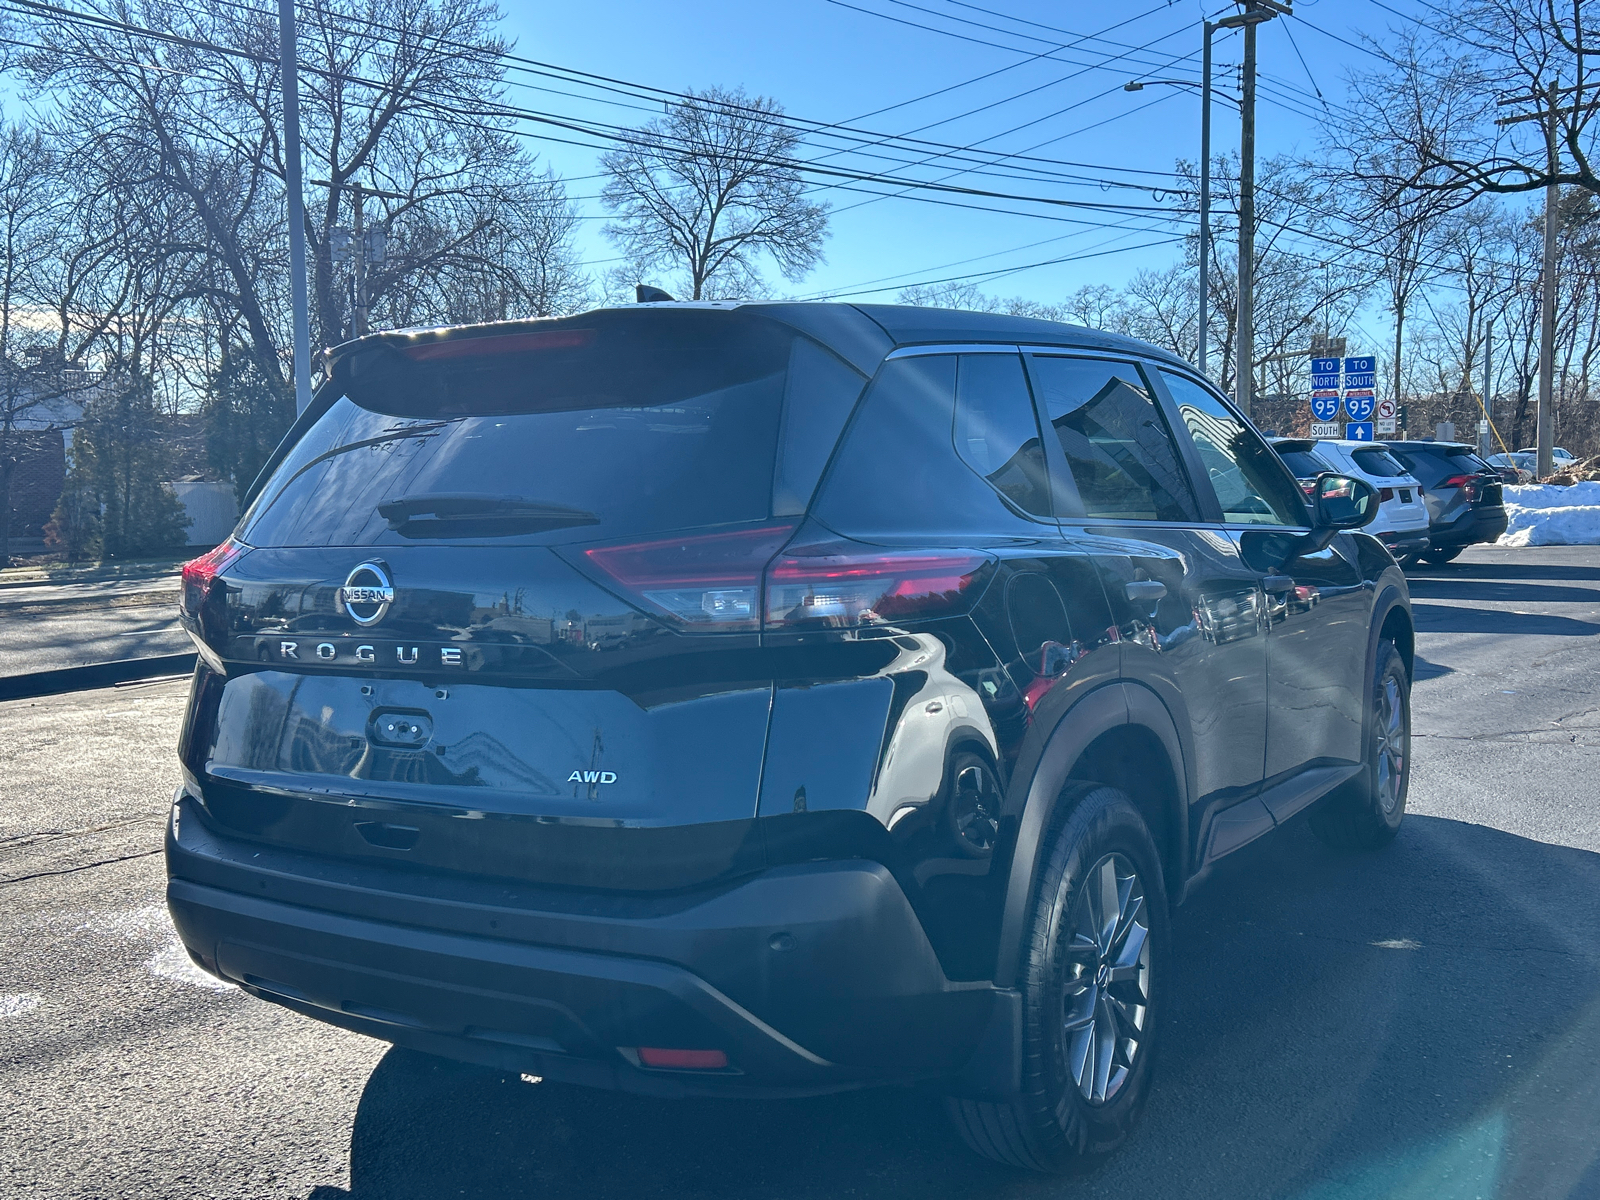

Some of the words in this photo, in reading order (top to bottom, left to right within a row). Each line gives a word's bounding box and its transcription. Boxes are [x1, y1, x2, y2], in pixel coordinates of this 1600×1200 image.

[1319, 361, 1333, 371] TO
[1353, 360, 1368, 370] TO
[1312, 376, 1340, 387] NORTH
[1346, 375, 1374, 386] SOUTH
[1315, 400, 1336, 415] 95
[1349, 400, 1371, 415] 95
[1312, 425, 1338, 436] SOUTH
[343, 590, 386, 600] NISSAN
[280, 641, 464, 666] ROGUE
[567, 770, 617, 784] AWD
